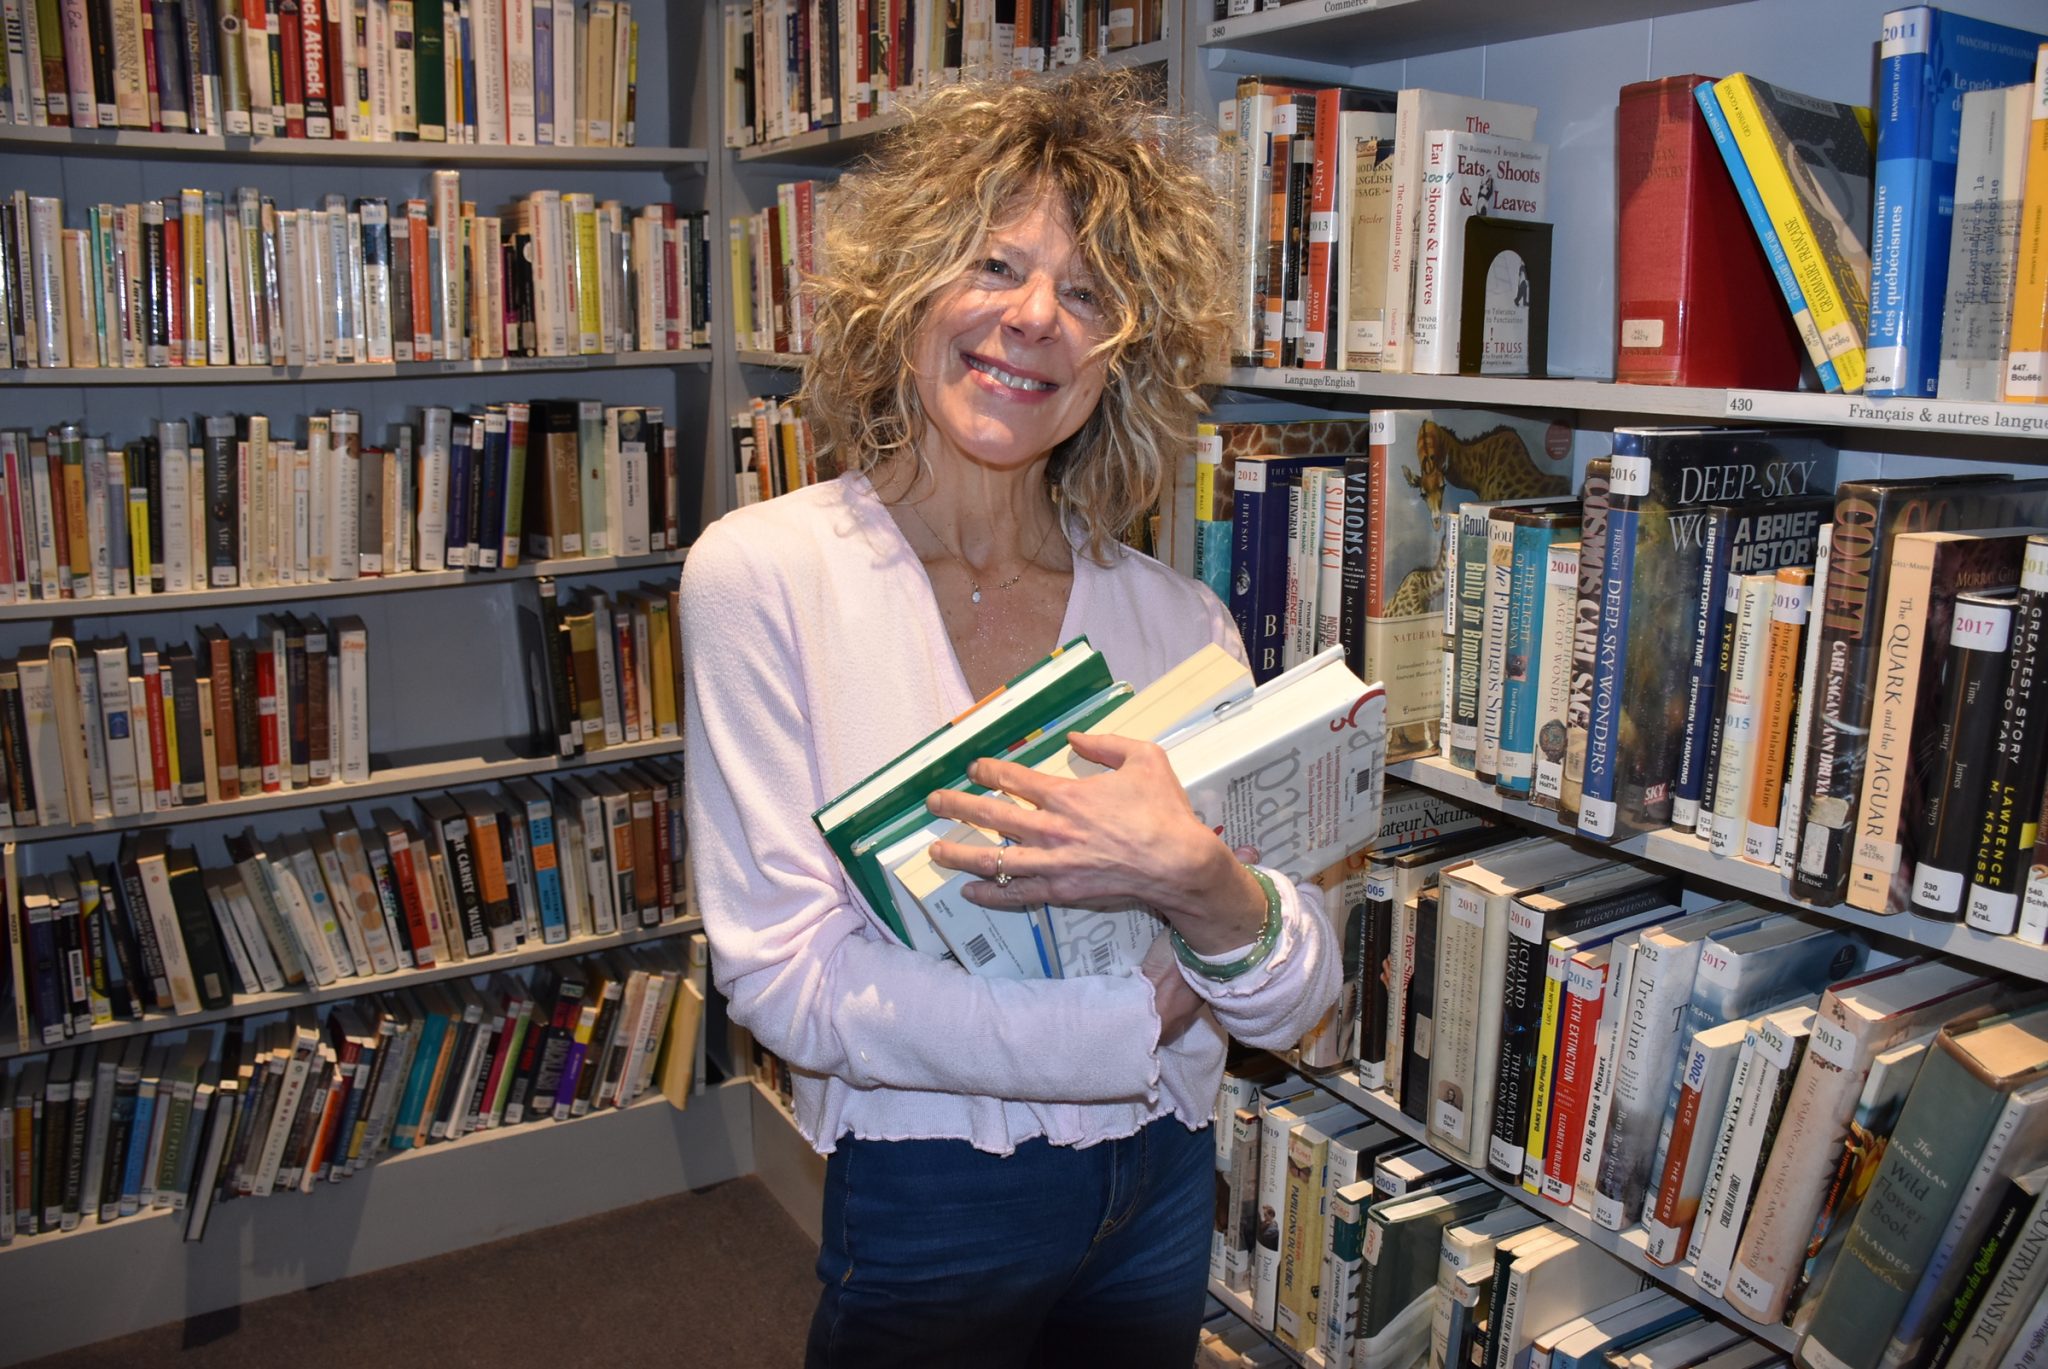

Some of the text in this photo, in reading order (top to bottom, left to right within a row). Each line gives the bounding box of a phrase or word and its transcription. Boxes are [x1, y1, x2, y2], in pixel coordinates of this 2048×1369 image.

[1212, 26, 1225, 38] 380
[1883, 23, 1917, 42] 2011
[304, 30, 323, 96] Attack
[1954, 73, 1967, 90] Le
[1466, 116, 1490, 134] The
[1316, 159, 1324, 202] AIN'T
[1497, 161, 1540, 183] Shoots
[1395, 199, 1405, 242] Canadian
[1459, 187, 1536, 213] & Leaves
[1392, 246, 1400, 273] Style
[1424, 186, 1441, 306] Shoots & Leaves
[1868, 185, 1888, 315] dictionnaire petit
[1803, 262, 1834, 313] GRAMMAIRE
[1883, 205, 1902, 336] québécismes des
[449, 308, 457, 329] Jung
[1495, 342, 1522, 353] TRUSS
[1284, 374, 1355, 388] Language/English
[1730, 399, 1753, 412] 430
[1849, 403, 1989, 426] Français & autres
[217, 455, 229, 499] MORAL
[1238, 471, 1258, 481] 2012
[1611, 468, 1637, 481] 2016
[1678, 461, 1817, 504] DEEP-SKY
[1240, 504, 1251, 552] BRYSON
[1322, 486, 1343, 569] SUZUKI
[1344, 472, 1367, 555] VISIONS
[1369, 461, 1380, 605] NATURAL HISTORIES
[1734, 517, 1750, 545] A
[1756, 511, 1818, 539] BRIEF
[1551, 560, 1576, 575] 2010
[1825, 499, 1877, 639] COMET
[1290, 578, 1298, 625] SCIENCE
[1693, 517, 1718, 668] A BRIEF HISTORY OF TIME
[1772, 594, 1800, 608] 2019
[1509, 597, 1520, 649] IGUANA
[1521, 588, 1533, 643] FLIGHT
[1735, 591, 1756, 681] Alan Lightman
[1956, 618, 1994, 636] 2017
[1458, 561, 1486, 721] Bully for Brontosaurus
[1589, 529, 1622, 776] FRENCH DEEP-SKY WONDERS
[1720, 624, 1732, 672] TYSON
[215, 662, 230, 712] JESUIT
[602, 662, 614, 698] GOD
[1549, 652, 1562, 713] WONDER
[1822, 641, 1847, 753] CARL SAGAN ANN
[2008, 608, 2043, 765] GREATEST STORY
[1484, 697, 1501, 750] Smile
[1680, 675, 1699, 785] STEPHEN HAWKING
[1762, 664, 1788, 808] Stars Maine
[1865, 598, 1914, 837] The QUARK and the JAGUAR
[1939, 680, 1980, 751] Time Travel
[1998, 720, 2010, 754] FAR
[1705, 718, 1721, 808] PEOPLE HURRY
[1645, 784, 1667, 799] SKY
[1927, 761, 1967, 826] James Gleick
[1975, 810, 1995, 884] KRAUSS
[1989, 786, 2015, 886] LAWRENCE
[457, 852, 477, 894] CARNEY
[1798, 873, 1823, 889] House
[1924, 881, 1938, 892] 530
[1458, 898, 1478, 914] 2012
[1510, 911, 1530, 929] 2010
[1574, 916, 1590, 928] THE
[1593, 909, 1614, 923] GOD
[1616, 897, 1657, 920] DELUSION
[1973, 901, 1988, 912] 530
[1405, 934, 1416, 960] Ever
[1701, 951, 1727, 972] 2017
[1439, 936, 1453, 1035] EDWARD WILSON
[1568, 971, 1593, 990] 2015
[1628, 977, 1655, 1061] Treeline
[1690, 1005, 1715, 1023] DEATH
[1564, 1024, 1580, 1083] EXTINCTION
[1759, 1026, 1783, 1052] 2022
[1816, 1027, 1842, 1051] 2013
[1219, 1083, 1240, 1095] 2006
[1501, 1040, 1513, 1096] SHOW ON
[1688, 1051, 1705, 1085] 2005
[1738, 1061, 1749, 1085] DRAKE
[1507, 1054, 1522, 1144] THE GREATEST
[1582, 1056, 1607, 1164] Du Big Bang Mozart
[1618, 1110, 1627, 1128] Ben
[1557, 1112, 1567, 1146] ELIZABETH
[1772, 1099, 1811, 1198] NAMING NAMES
[1913, 1137, 1934, 1159] The
[1983, 1110, 2018, 1174] LOCKER
[1329, 1151, 1348, 1168] 2020
[1554, 1148, 1564, 1182] KOLBERT
[1604, 1132, 1624, 1184] Rawlence
[1892, 1140, 1948, 1190] MACMILLAN
[1376, 1175, 1397, 1193] 2005
[1662, 1160, 1681, 1219] THE TIDES
[1874, 1174, 1927, 1225] Flower
[1891, 1159, 1931, 1202] Wild
[1869, 1198, 1911, 1243] Book
[1441, 1248, 1460, 1266] 2006
[1965, 1238, 1999, 1290] du Québec
[1504, 1281, 1518, 1332] THE NATURE
